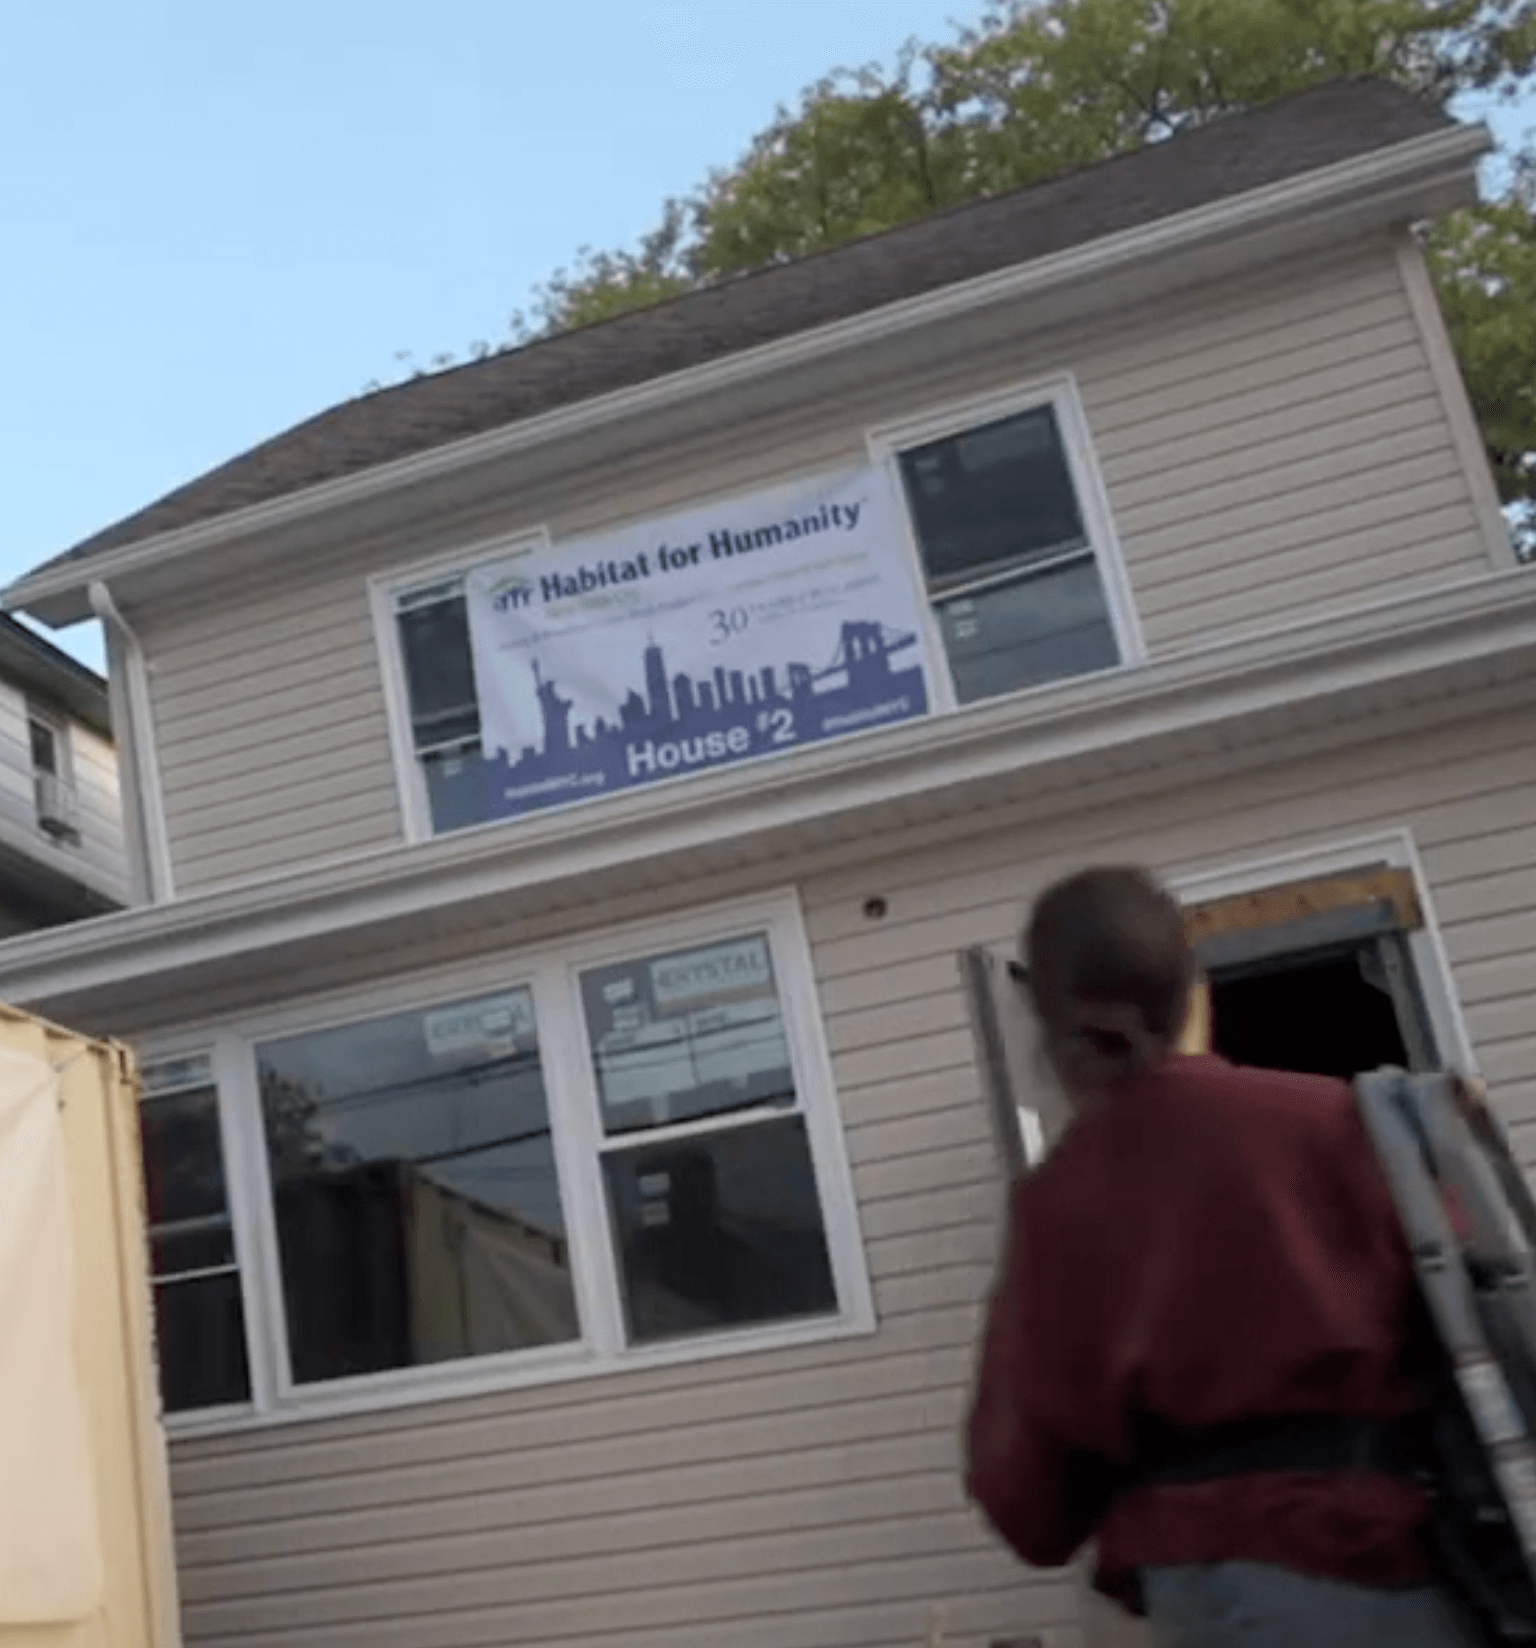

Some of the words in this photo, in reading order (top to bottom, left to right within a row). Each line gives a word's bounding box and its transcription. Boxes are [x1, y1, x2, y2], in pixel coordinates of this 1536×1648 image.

[539, 551, 651, 604] Habitat
[658, 536, 703, 574] for
[707, 500, 862, 561] Humanity
[707, 605, 749, 646] 30
[626, 720, 750, 777] House
